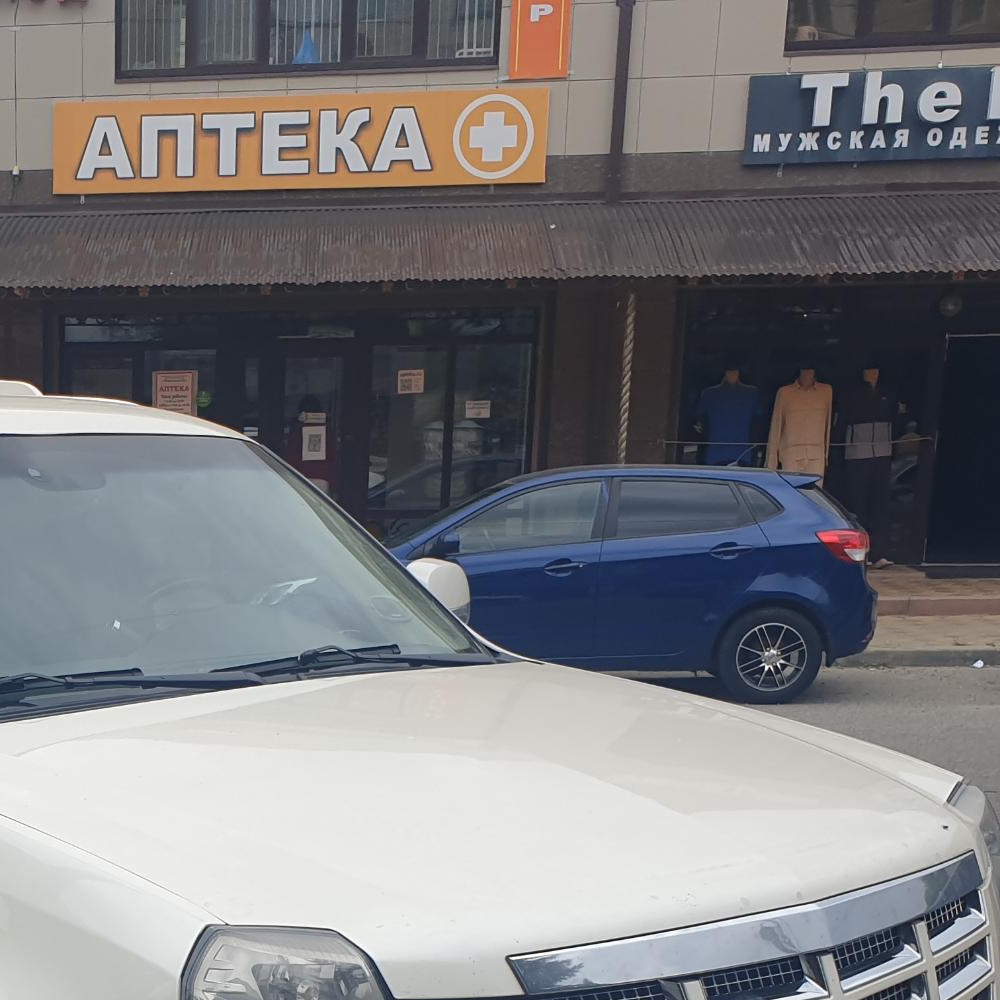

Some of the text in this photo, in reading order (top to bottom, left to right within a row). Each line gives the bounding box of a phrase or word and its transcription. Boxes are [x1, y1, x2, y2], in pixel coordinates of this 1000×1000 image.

[801, 71, 962, 127] The
[75, 107, 433, 180] АПТЕКА
[753, 128, 910, 153] МУЖСКАЯ
